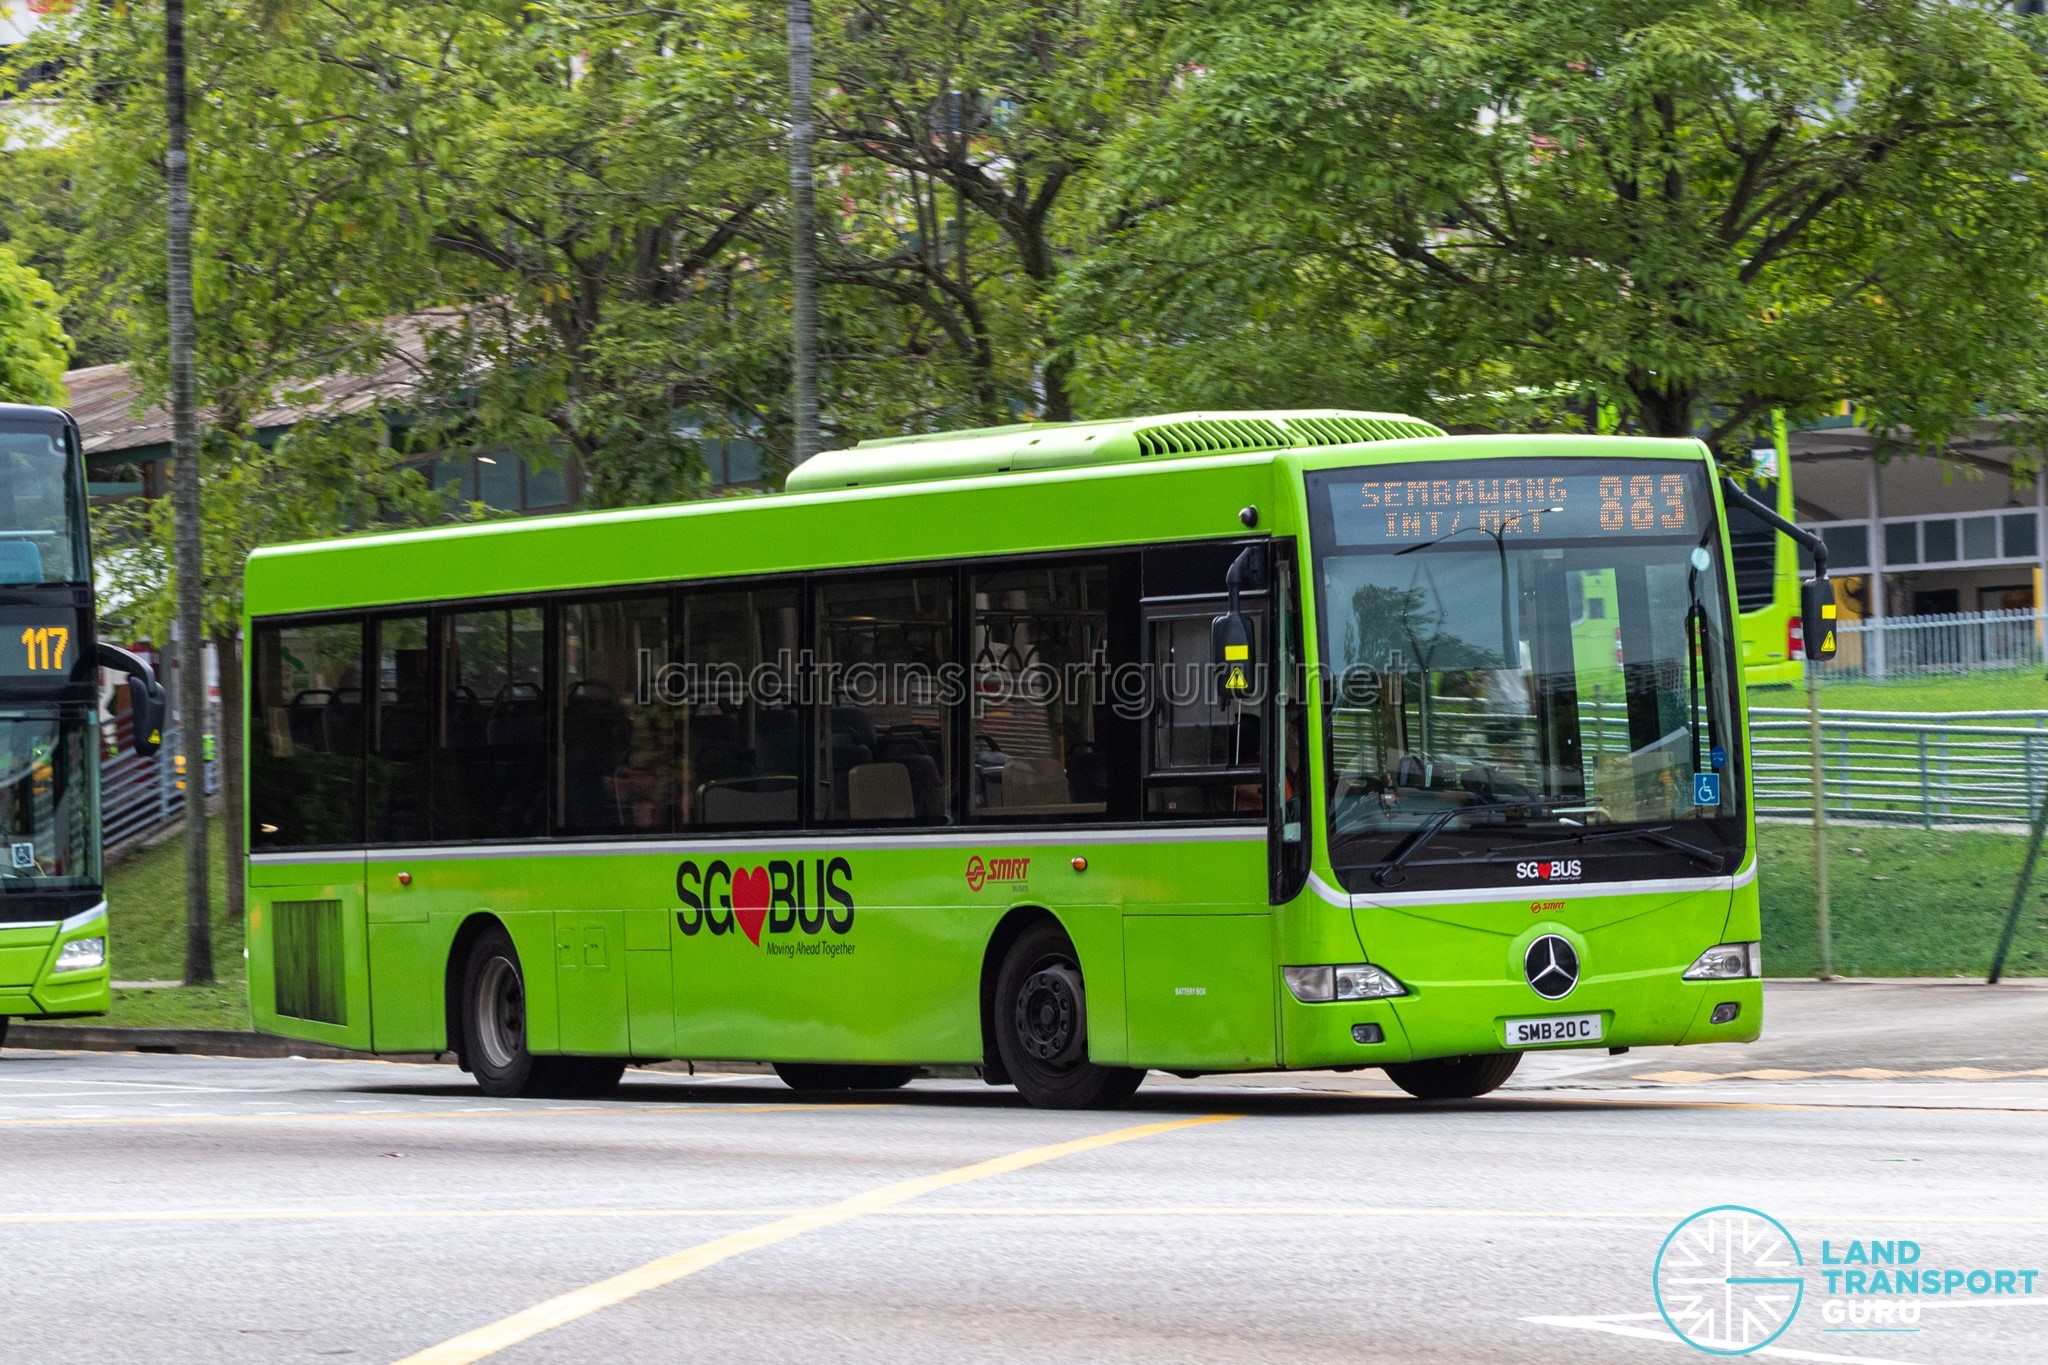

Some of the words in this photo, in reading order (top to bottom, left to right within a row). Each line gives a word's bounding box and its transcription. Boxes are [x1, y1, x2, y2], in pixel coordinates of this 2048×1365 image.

[1361, 477, 1568, 508] SEMBAWANG
[1598, 474, 1686, 532] 883
[1385, 511, 1461, 538] INT/
[1478, 507, 1545, 535] MRT
[21, 626, 69, 671] 117
[986, 857, 1031, 880] SMRT
[1541, 901, 1566, 911] SMRT
[766, 941, 795, 959] Moving
[796, 941, 821, 956] Ahead
[822, 940, 856, 959] Together
